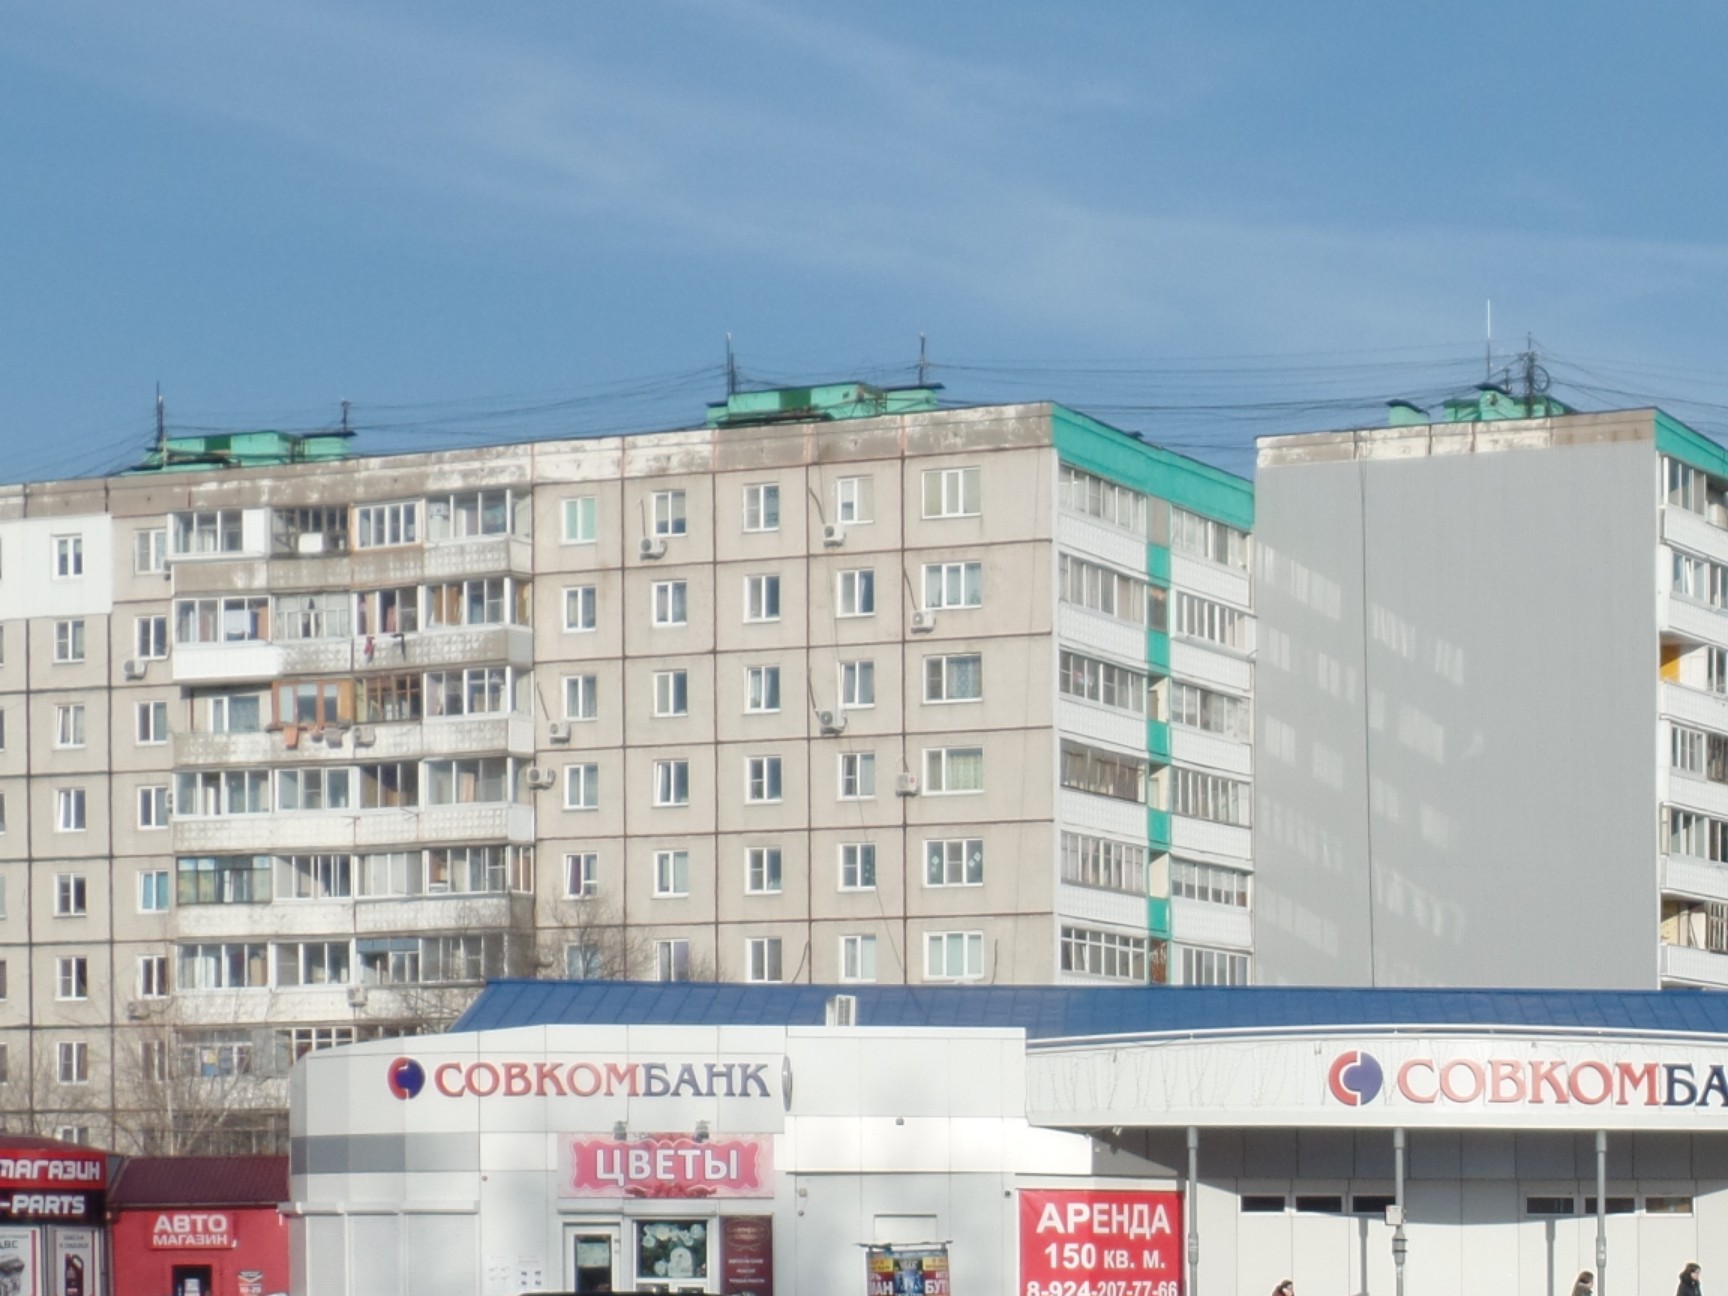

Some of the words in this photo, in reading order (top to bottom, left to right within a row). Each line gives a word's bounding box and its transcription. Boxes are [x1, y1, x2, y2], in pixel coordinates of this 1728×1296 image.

[434, 1061, 770, 1097] СОВКОМБАНК
[596, 1149, 738, 1186] ЦВЕТЫ
[153, 1213, 228, 1234] АВТО
[1036, 1202, 1171, 1240] АРЕНДА
[153, 1233, 228, 1246] МАГАЗИН
[1045, 1243, 1096, 1269] 150
